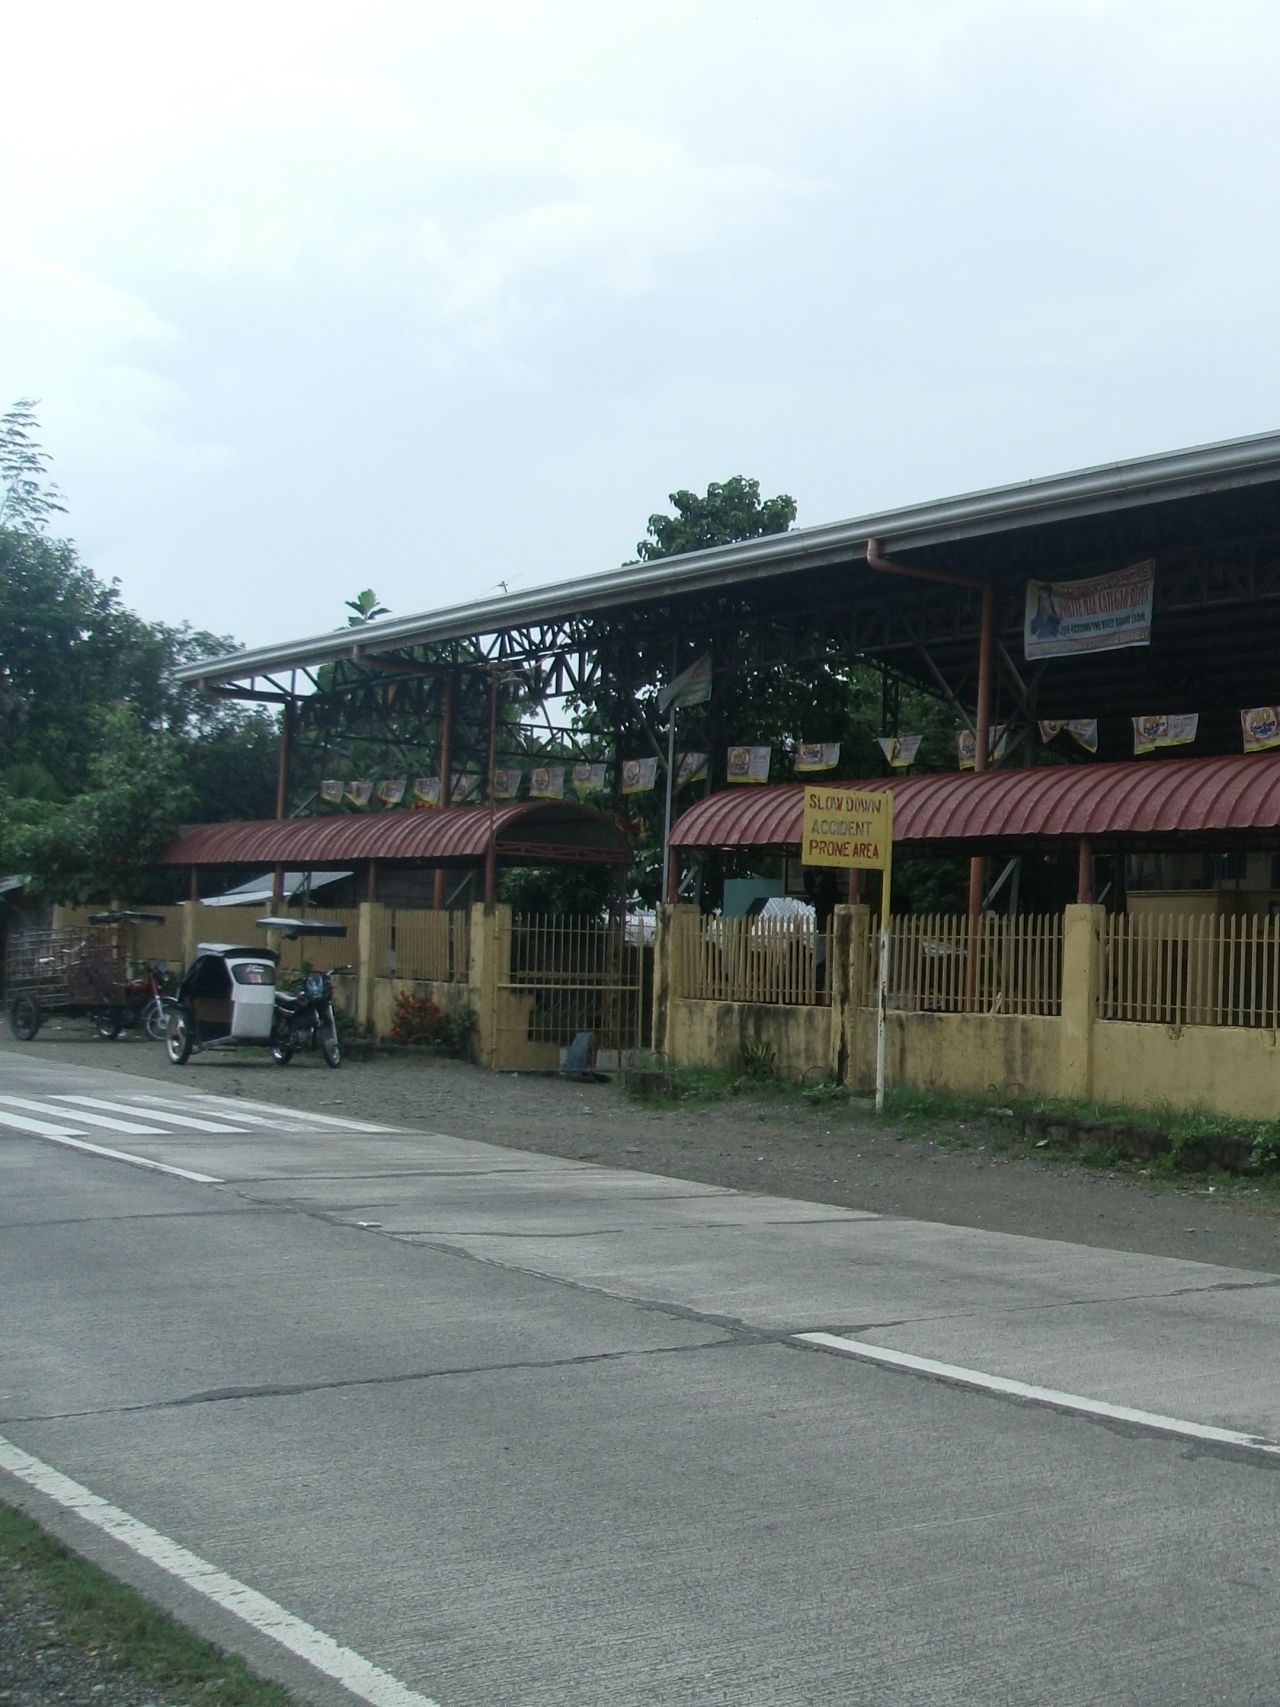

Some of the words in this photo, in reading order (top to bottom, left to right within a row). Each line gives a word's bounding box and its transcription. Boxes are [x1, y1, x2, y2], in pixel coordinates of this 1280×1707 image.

[809, 794, 844, 811] SLOW
[846, 797, 882, 814] DOWN
[811, 819, 873, 837] ACCIDENT
[809, 839, 851, 857] PRONE
[852, 843, 880, 859] AREA
